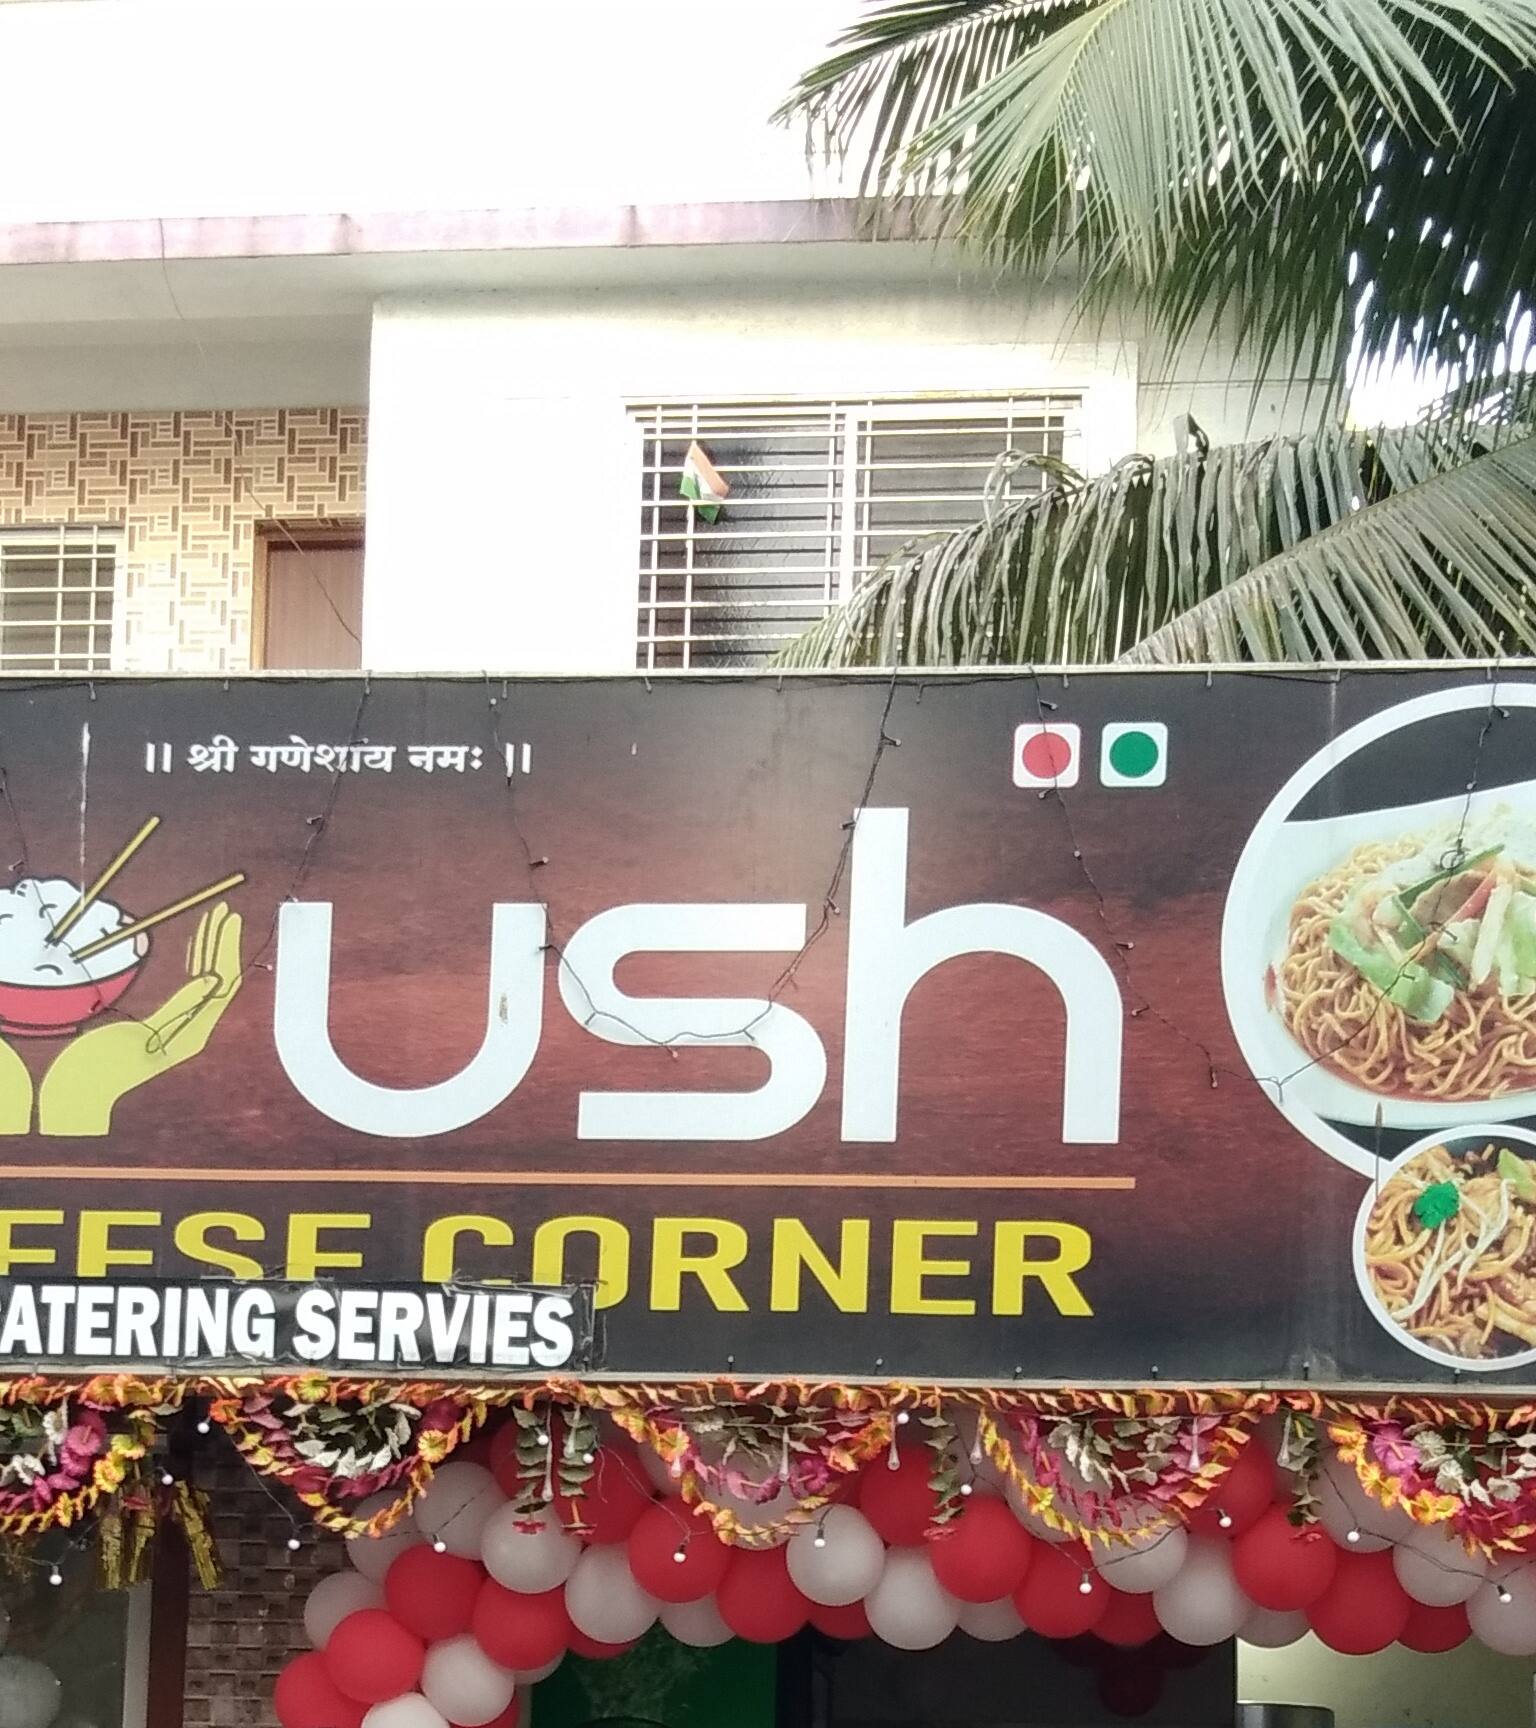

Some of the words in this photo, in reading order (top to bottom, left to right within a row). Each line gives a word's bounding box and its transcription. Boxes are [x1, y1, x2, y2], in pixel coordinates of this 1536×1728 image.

[186, 734, 240, 773] श्री
[249, 734, 397, 774] गणेशाय
[422, 1213, 1095, 1317] CORNER
[292, 1285, 575, 1368] SERVIES
